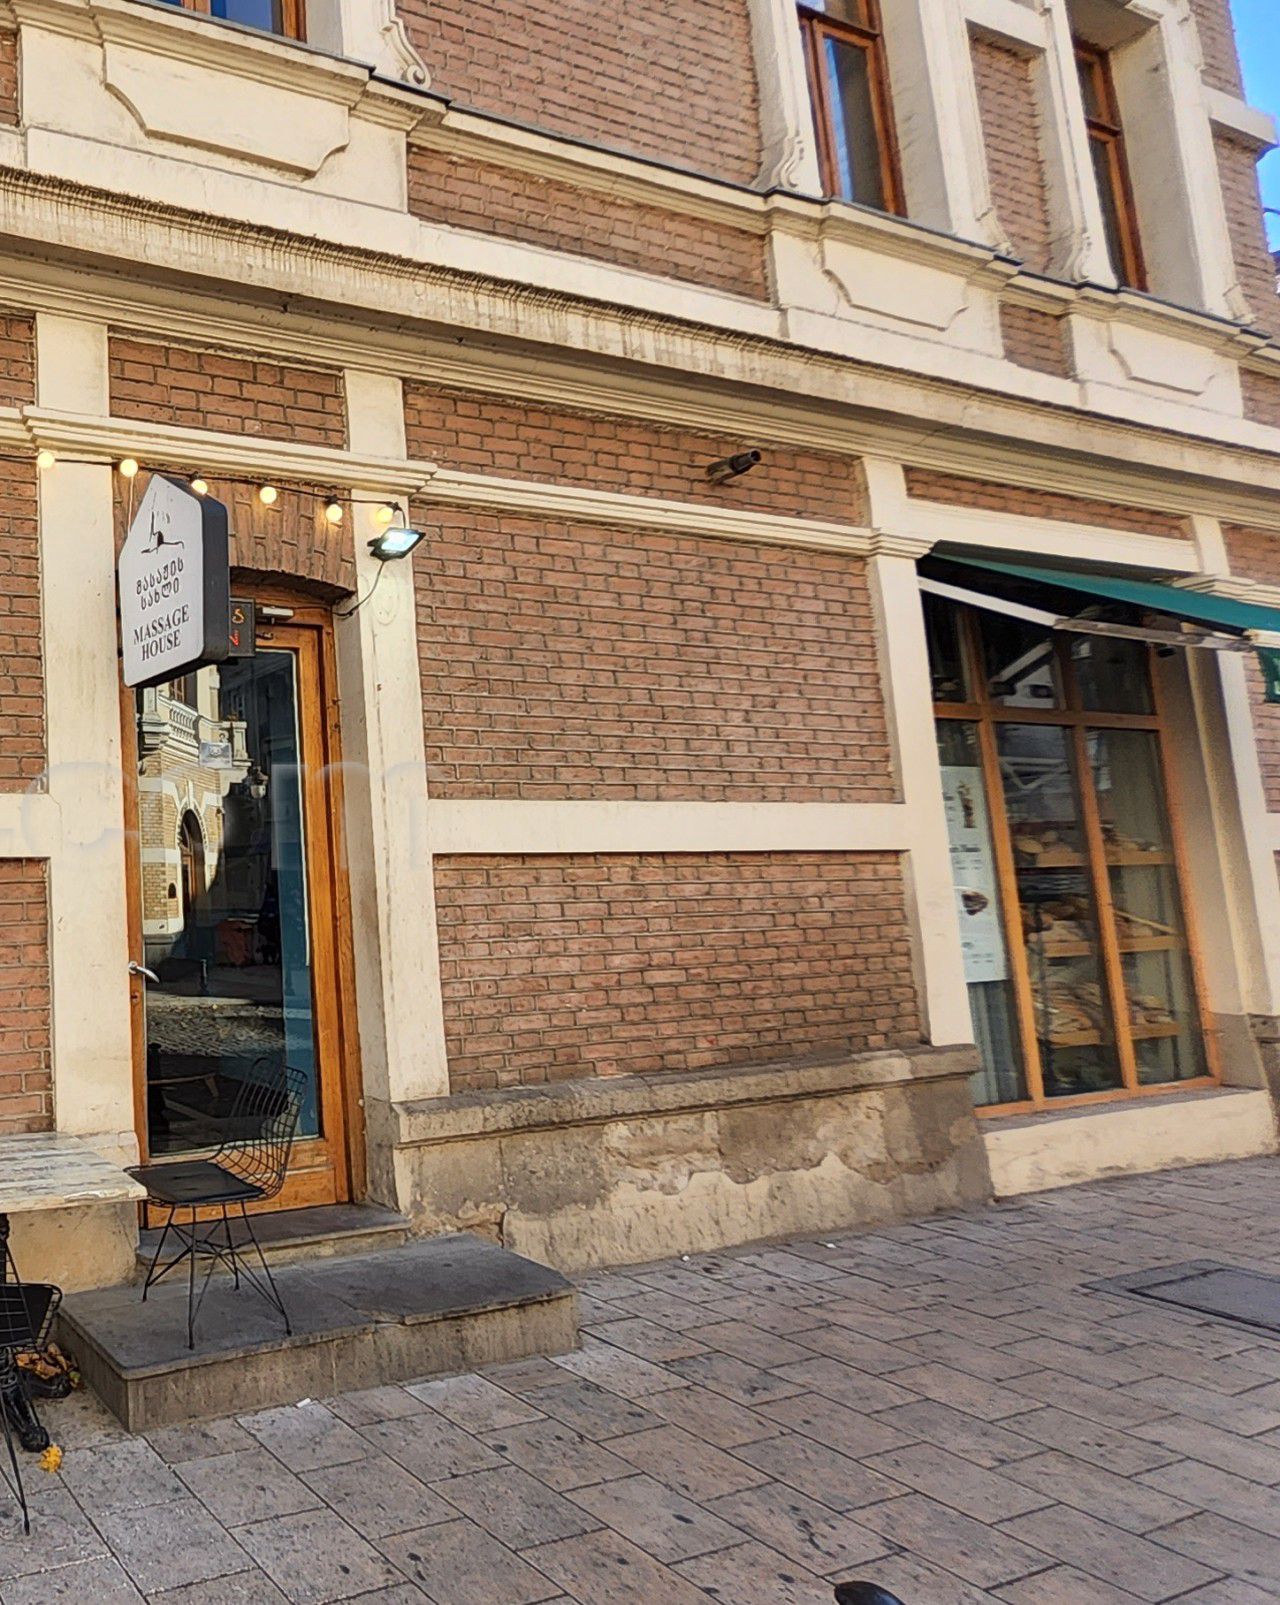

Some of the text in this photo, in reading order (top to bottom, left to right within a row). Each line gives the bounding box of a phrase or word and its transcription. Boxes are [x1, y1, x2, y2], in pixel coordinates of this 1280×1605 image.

[135, 556, 184, 596] მასაჟის
[140, 576, 180, 611] სახლი
[133, 603, 190, 646] MASSAGE
[141, 628, 182, 661] HOUSE
